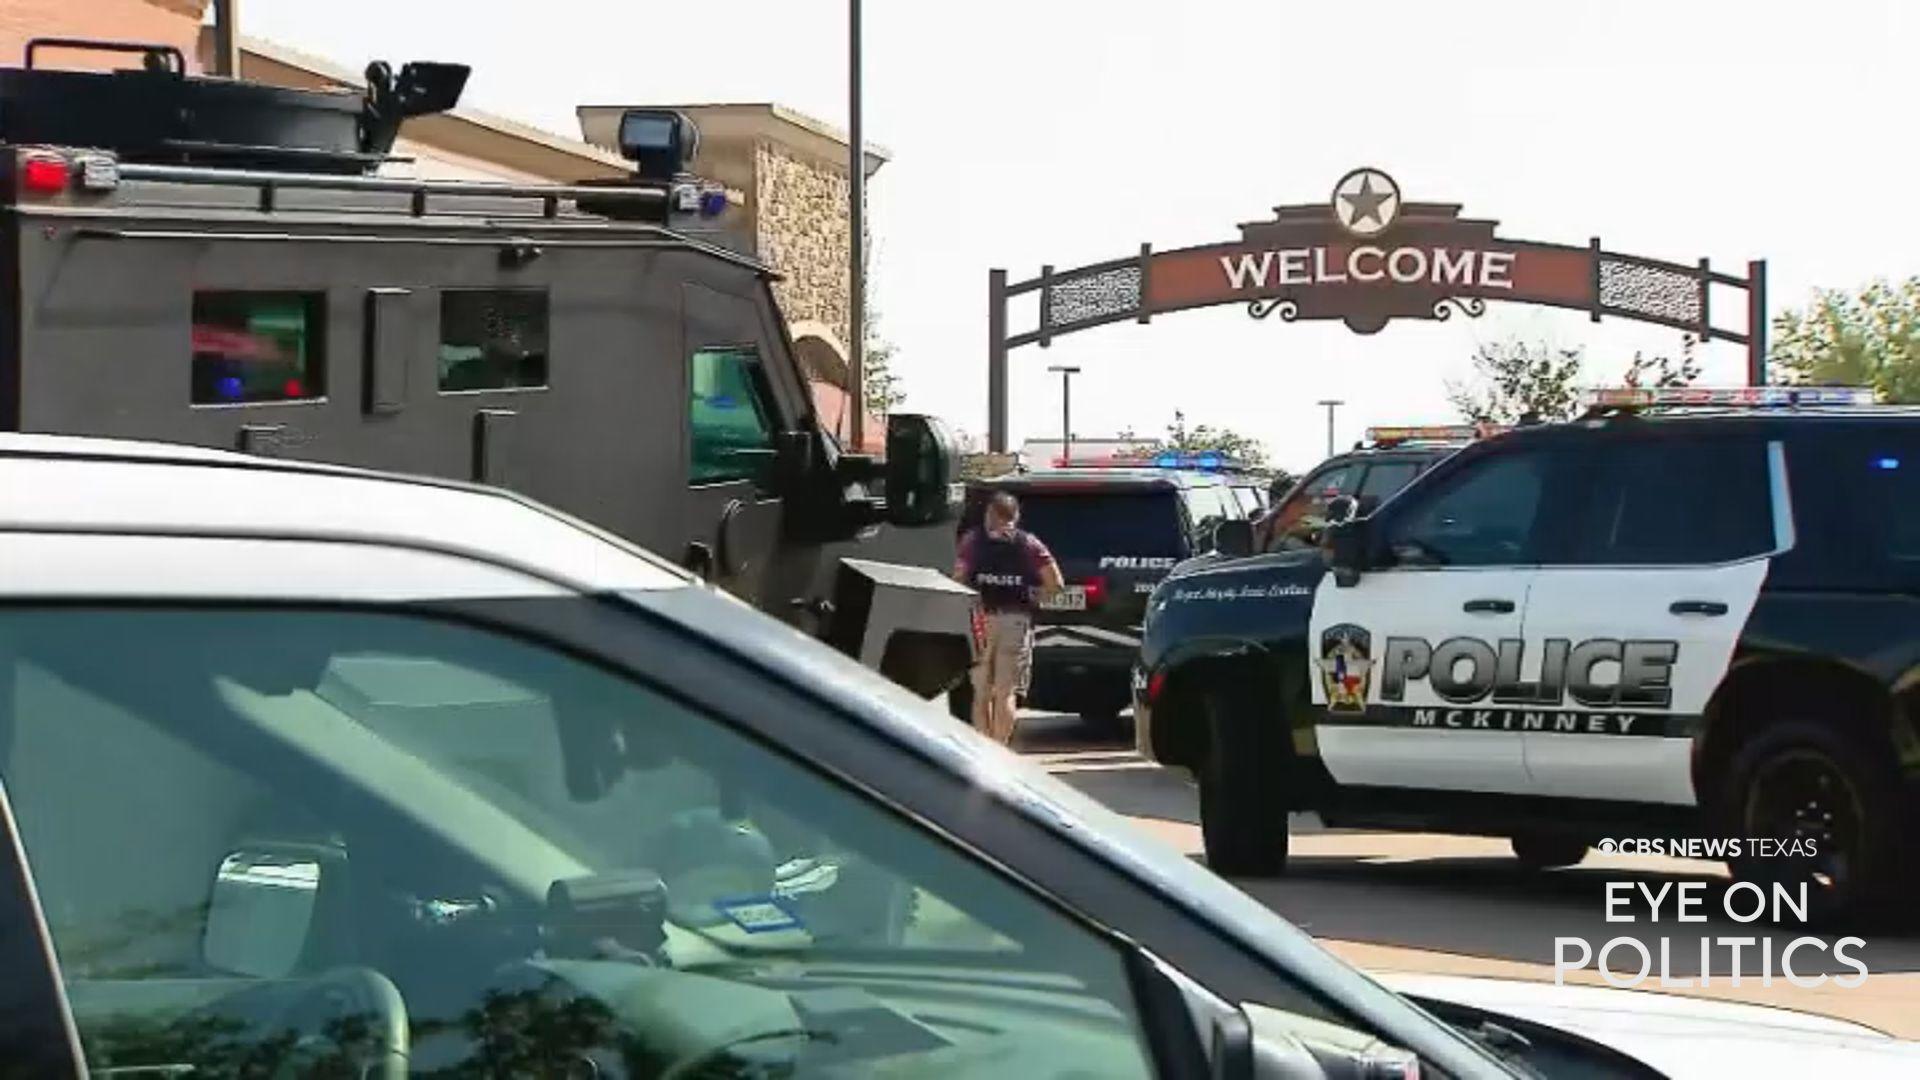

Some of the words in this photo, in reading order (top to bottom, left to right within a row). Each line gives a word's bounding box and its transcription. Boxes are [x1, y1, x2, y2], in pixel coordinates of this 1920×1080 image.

[1220, 246, 1516, 289] WELCOME
[1099, 555, 1177, 569] POLICE
[976, 573, 1023, 586] POLICE
[1380, 635, 1680, 709] POLICE
[1413, 709, 1638, 734] MCKINNEY
